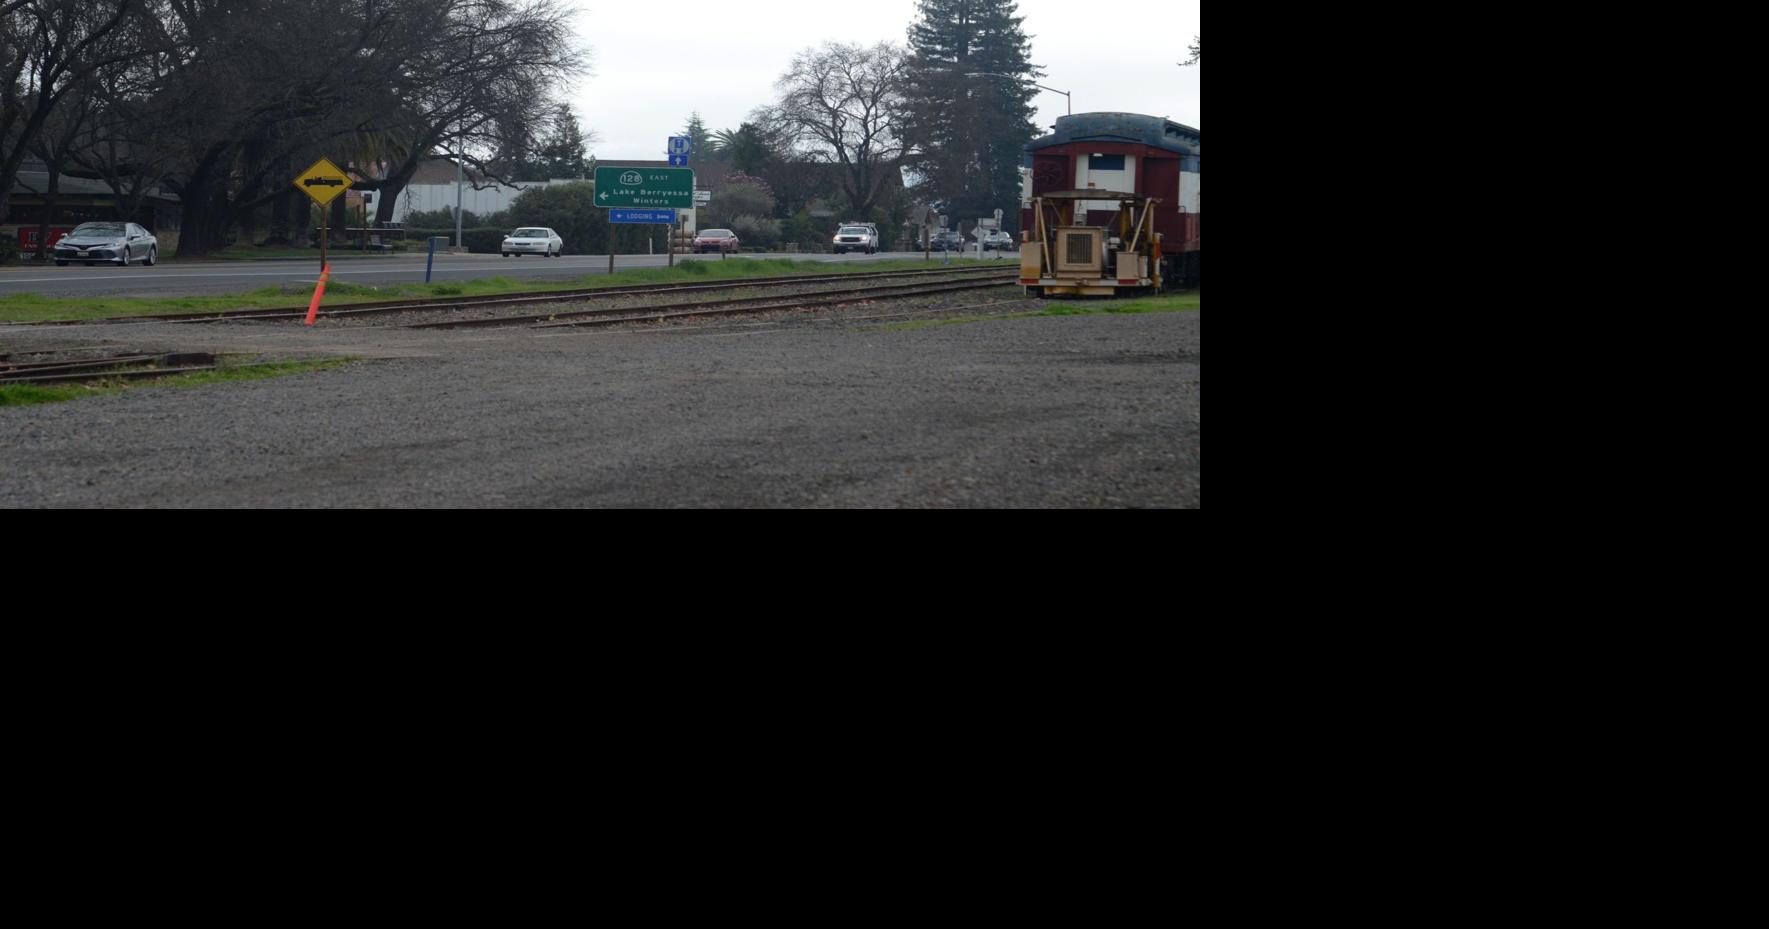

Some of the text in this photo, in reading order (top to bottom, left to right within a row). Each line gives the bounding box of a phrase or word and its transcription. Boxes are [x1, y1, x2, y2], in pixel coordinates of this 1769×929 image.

[622, 174, 640, 183] 128
[640, 189, 689, 197] Berryessa
[633, 197, 669, 205] Winters
